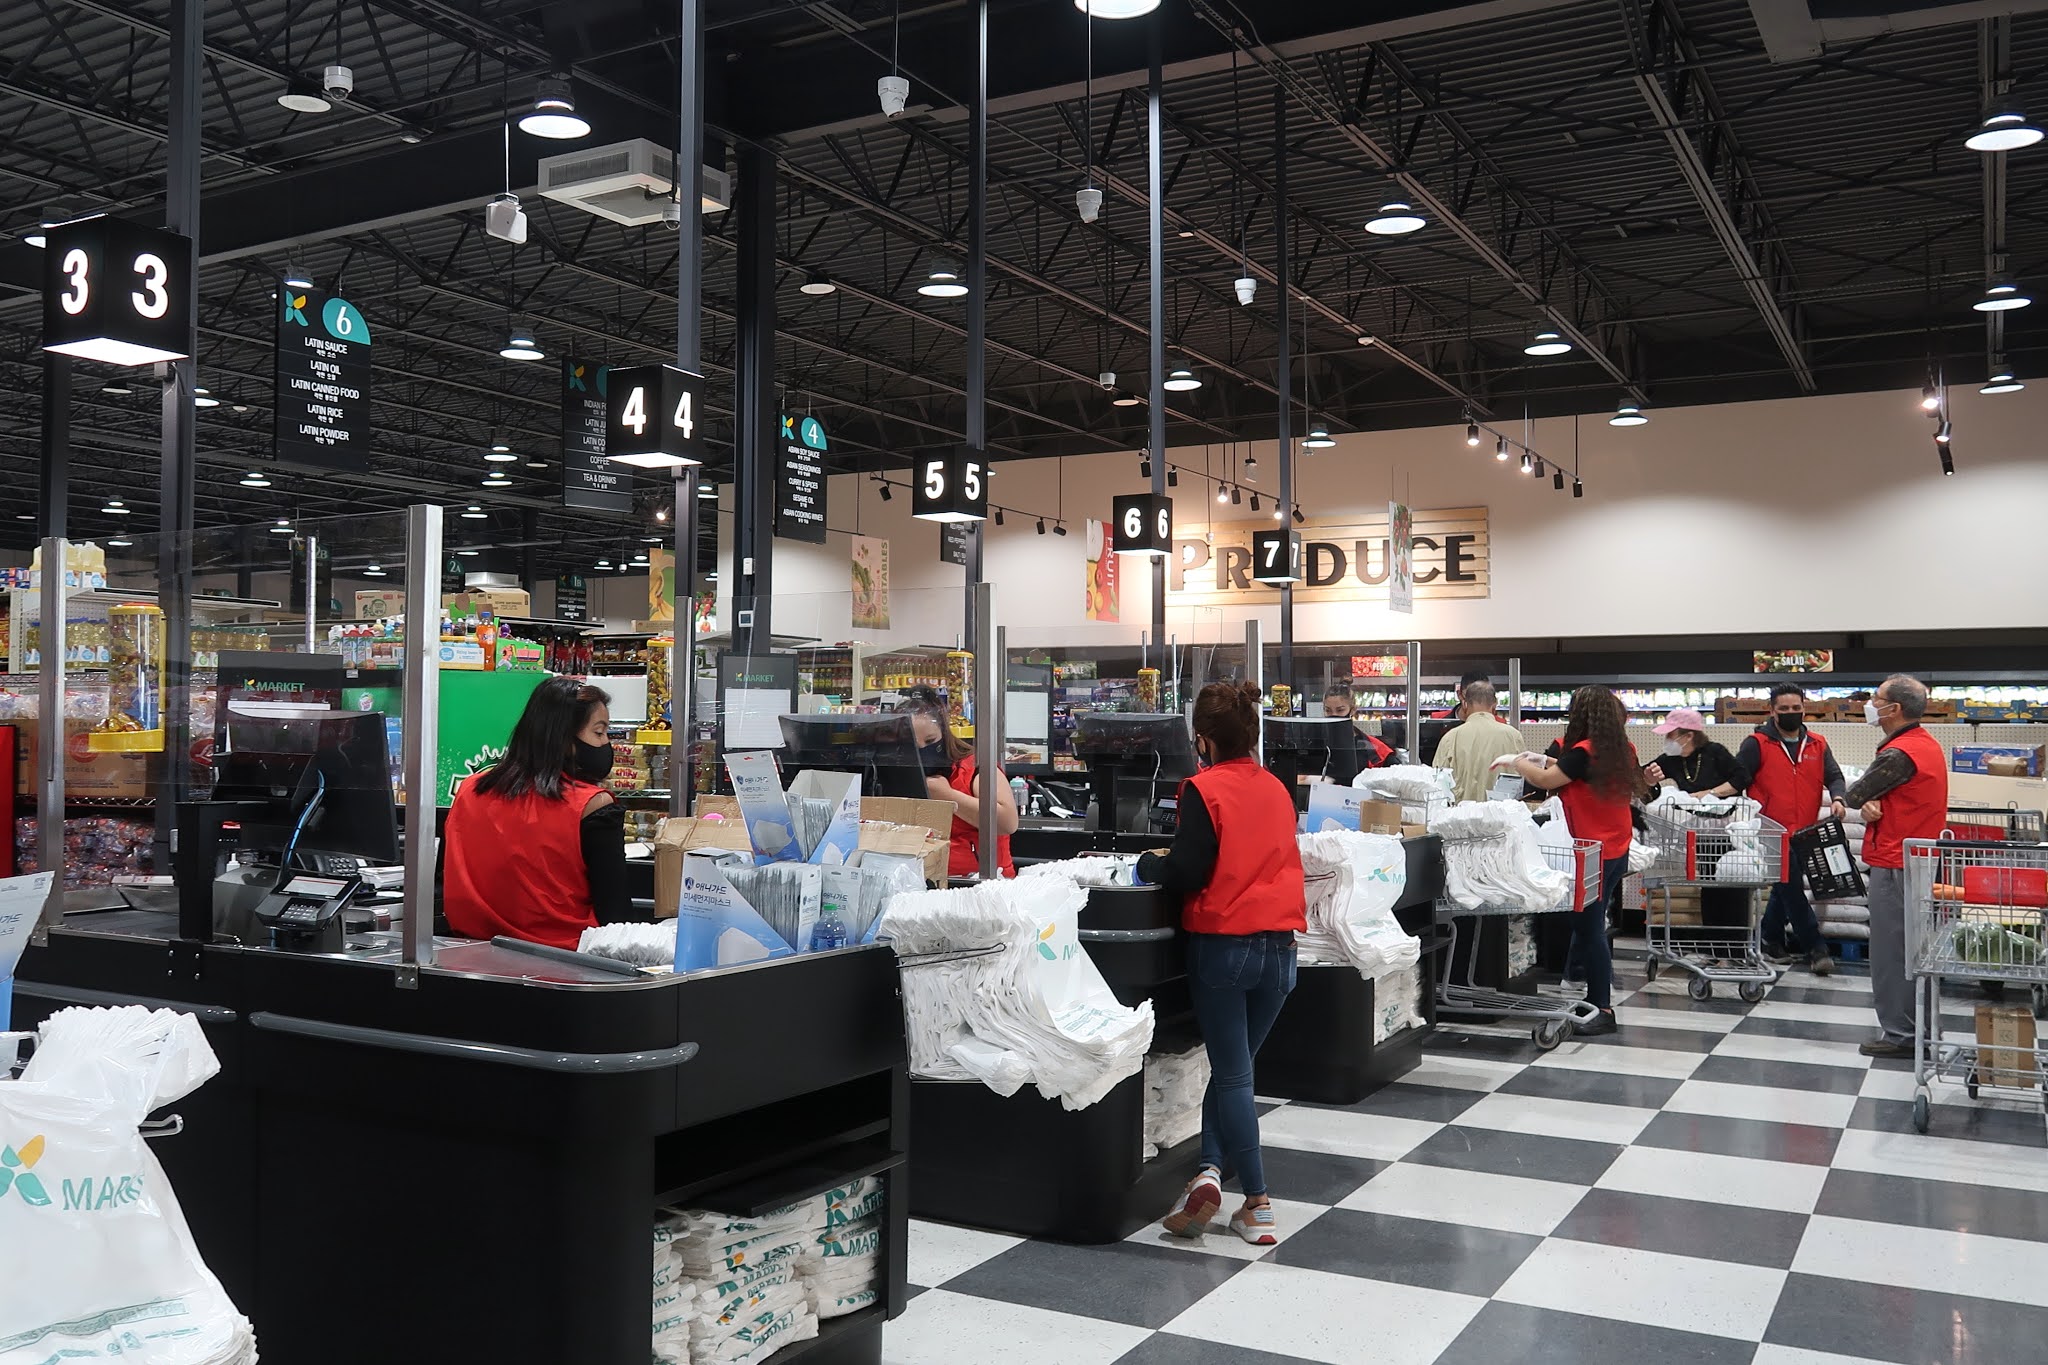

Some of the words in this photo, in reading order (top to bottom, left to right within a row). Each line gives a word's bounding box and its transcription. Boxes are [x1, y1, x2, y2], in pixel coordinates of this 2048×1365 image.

[61, 248, 90, 316] 3
[131, 253, 170, 320] 3
[336, 306, 352, 335] 6
[304, 336, 324, 350] LATIN
[324, 340, 348, 355] SAUCE
[310, 359, 330, 373] LATIN
[330, 364, 342, 375] OIL
[291, 378, 311, 391] LATIN
[311, 382, 340, 396] CANNED
[340, 387, 360, 400] FOOD
[307, 403, 327, 416] LATIN
[327, 407, 344, 419] RICE
[583, 399, 601, 410] INDIAN
[621, 386, 647, 435] 4
[674, 391, 693, 440] 4
[299, 423, 319, 437] LATIN
[319, 427, 350, 441] POWDER
[585, 418, 600, 429] LATIN
[808, 423, 819, 445] 4
[583, 436, 598, 446] LATIN
[589, 455, 610, 466] COFFEE
[583, 473, 594, 482] TEA
[598, 475, 617, 485] DRINKS
[924, 460, 945, 500] 5
[964, 462, 981, 501] 5
[1124, 507, 1142, 539] 6
[1158, 508, 1168, 539] 6
[1106, 536, 1115, 589] FRUIT
[1169, 534, 1477, 592] PRDUCE
[1263, 540, 1281, 568] 7
[1291, 541, 1299, 569] 7
[1780, 656, 1805, 666] SALAD
[256, 681, 305, 693] MARKET
[743, 673, 775, 683] MARKET
[695, 882, 728, 895] 애니가드
[683, 892, 732, 908] 미세먼지마스크
